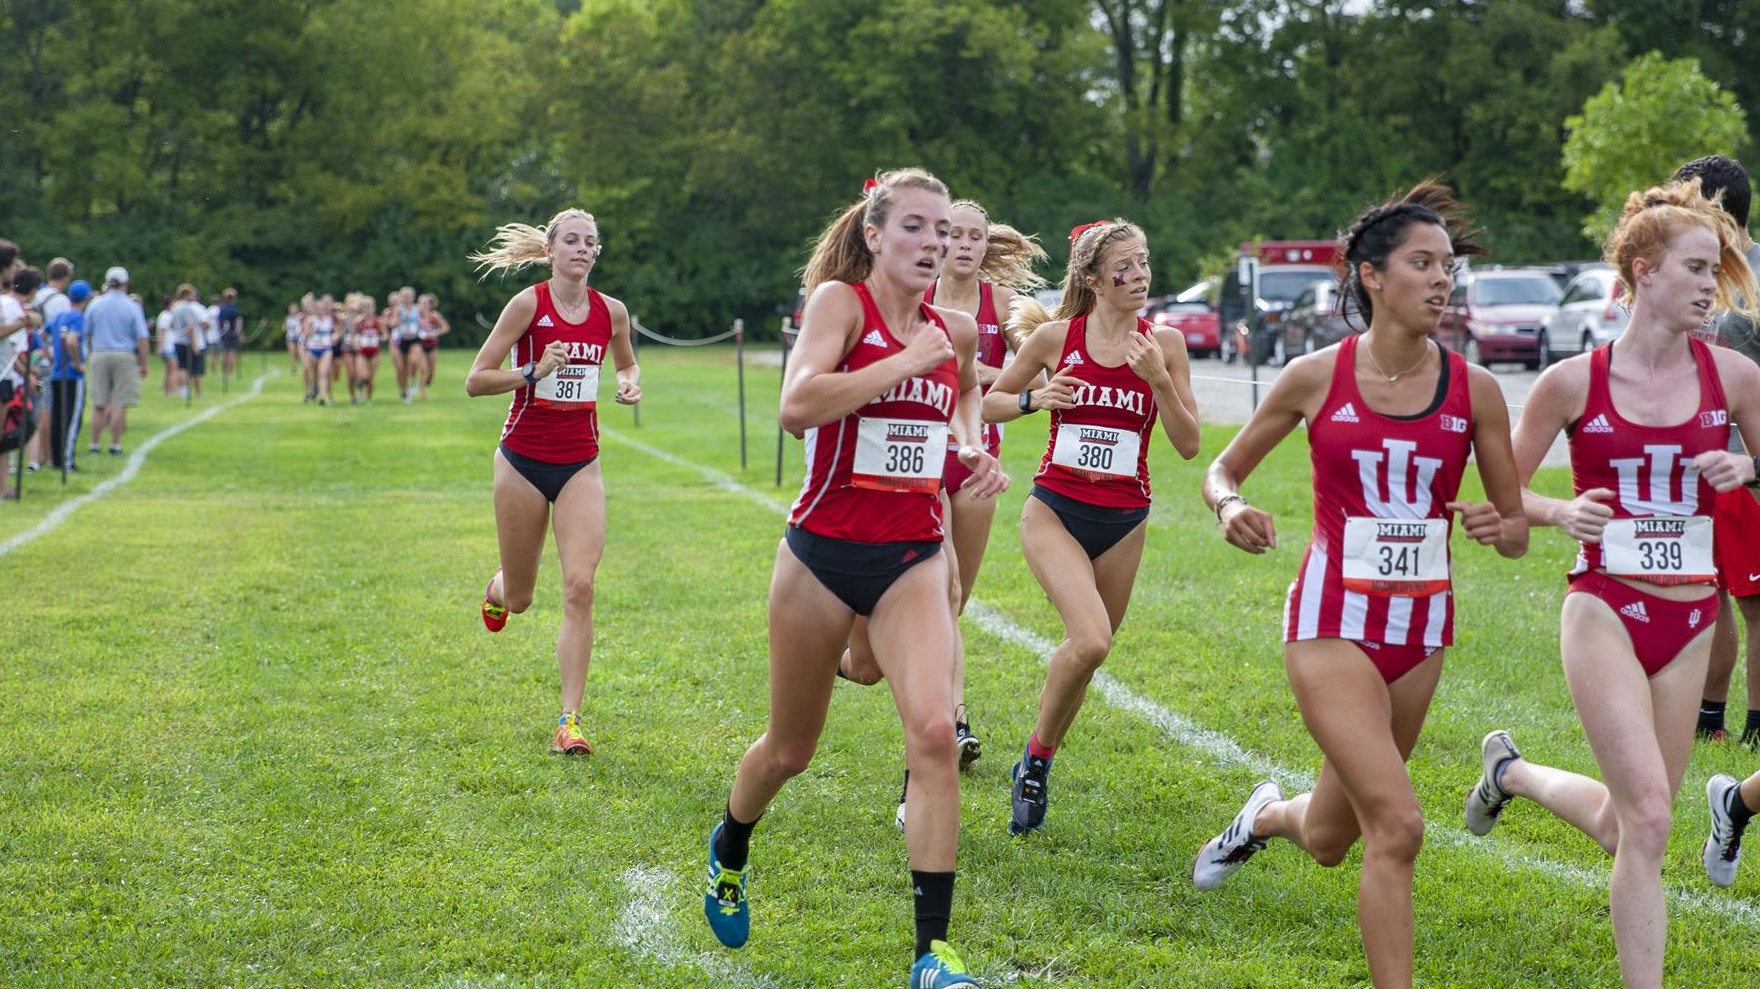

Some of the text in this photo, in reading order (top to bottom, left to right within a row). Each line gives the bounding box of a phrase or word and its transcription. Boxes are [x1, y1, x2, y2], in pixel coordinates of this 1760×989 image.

[563, 342, 603, 364] AMI
[556, 381, 582, 399] 381
[1071, 385, 1145, 415] MIAMI
[889, 424, 928, 437] MIAMI
[1081, 428, 1119, 442] MIAMI
[885, 445, 925, 474] 386
[1078, 445, 1114, 470] 380
[1379, 524, 1425, 537] MIAMI
[1636, 520, 1684, 532] MIAMI
[1378, 546, 1419, 577] 341
[1638, 541, 1683, 570] 339
